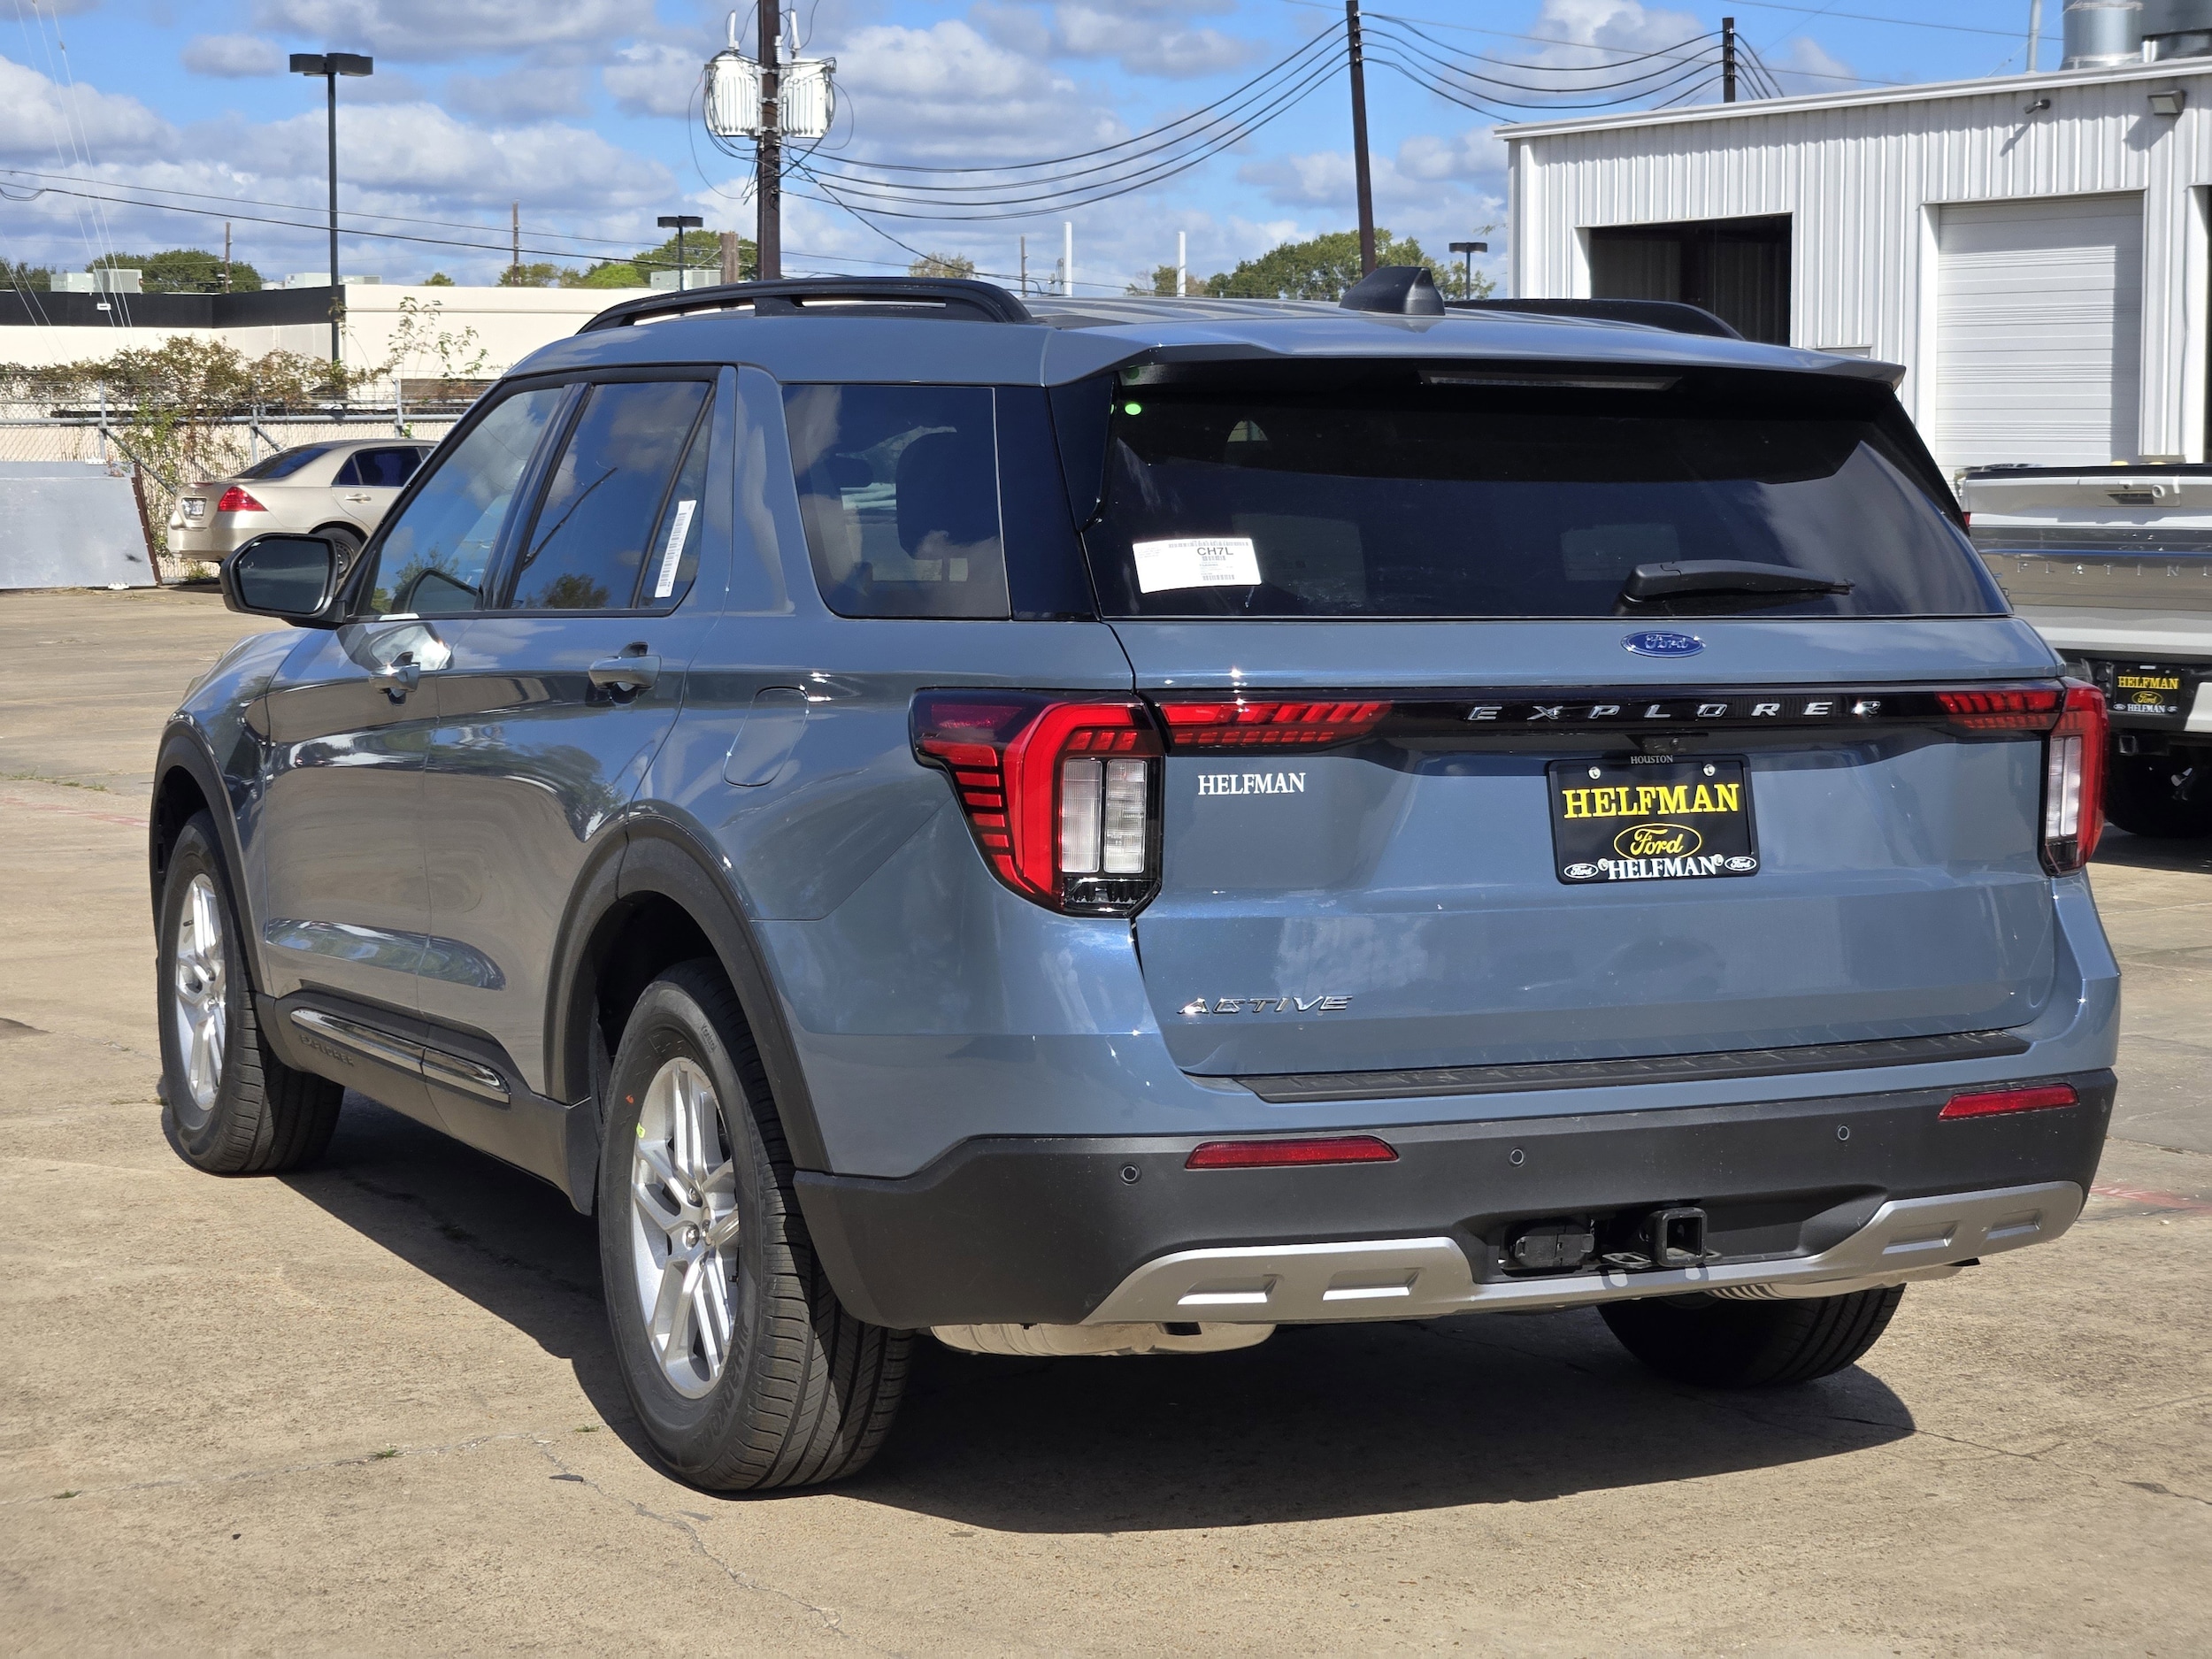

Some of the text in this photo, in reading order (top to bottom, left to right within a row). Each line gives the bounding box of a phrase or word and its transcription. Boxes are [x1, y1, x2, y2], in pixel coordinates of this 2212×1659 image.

[1196, 547, 1234, 557] CH7L
[2117, 675, 2179, 689] HELFMAN
[1467, 701, 1882, 721] EXPLORER
[2127, 703, 2166, 713] HELFMAN
[1630, 755, 1673, 764] HOUSTON
[1197, 772, 1306, 795] HELFMAN
[1562, 783, 1740, 818] HELFMAN
[1630, 828, 1684, 856] Ford
[1607, 856, 1717, 879] HELFMAN
[1176, 995, 1354, 1014] ACTIVE
[300, 1034, 354, 1067] EXPLORER
